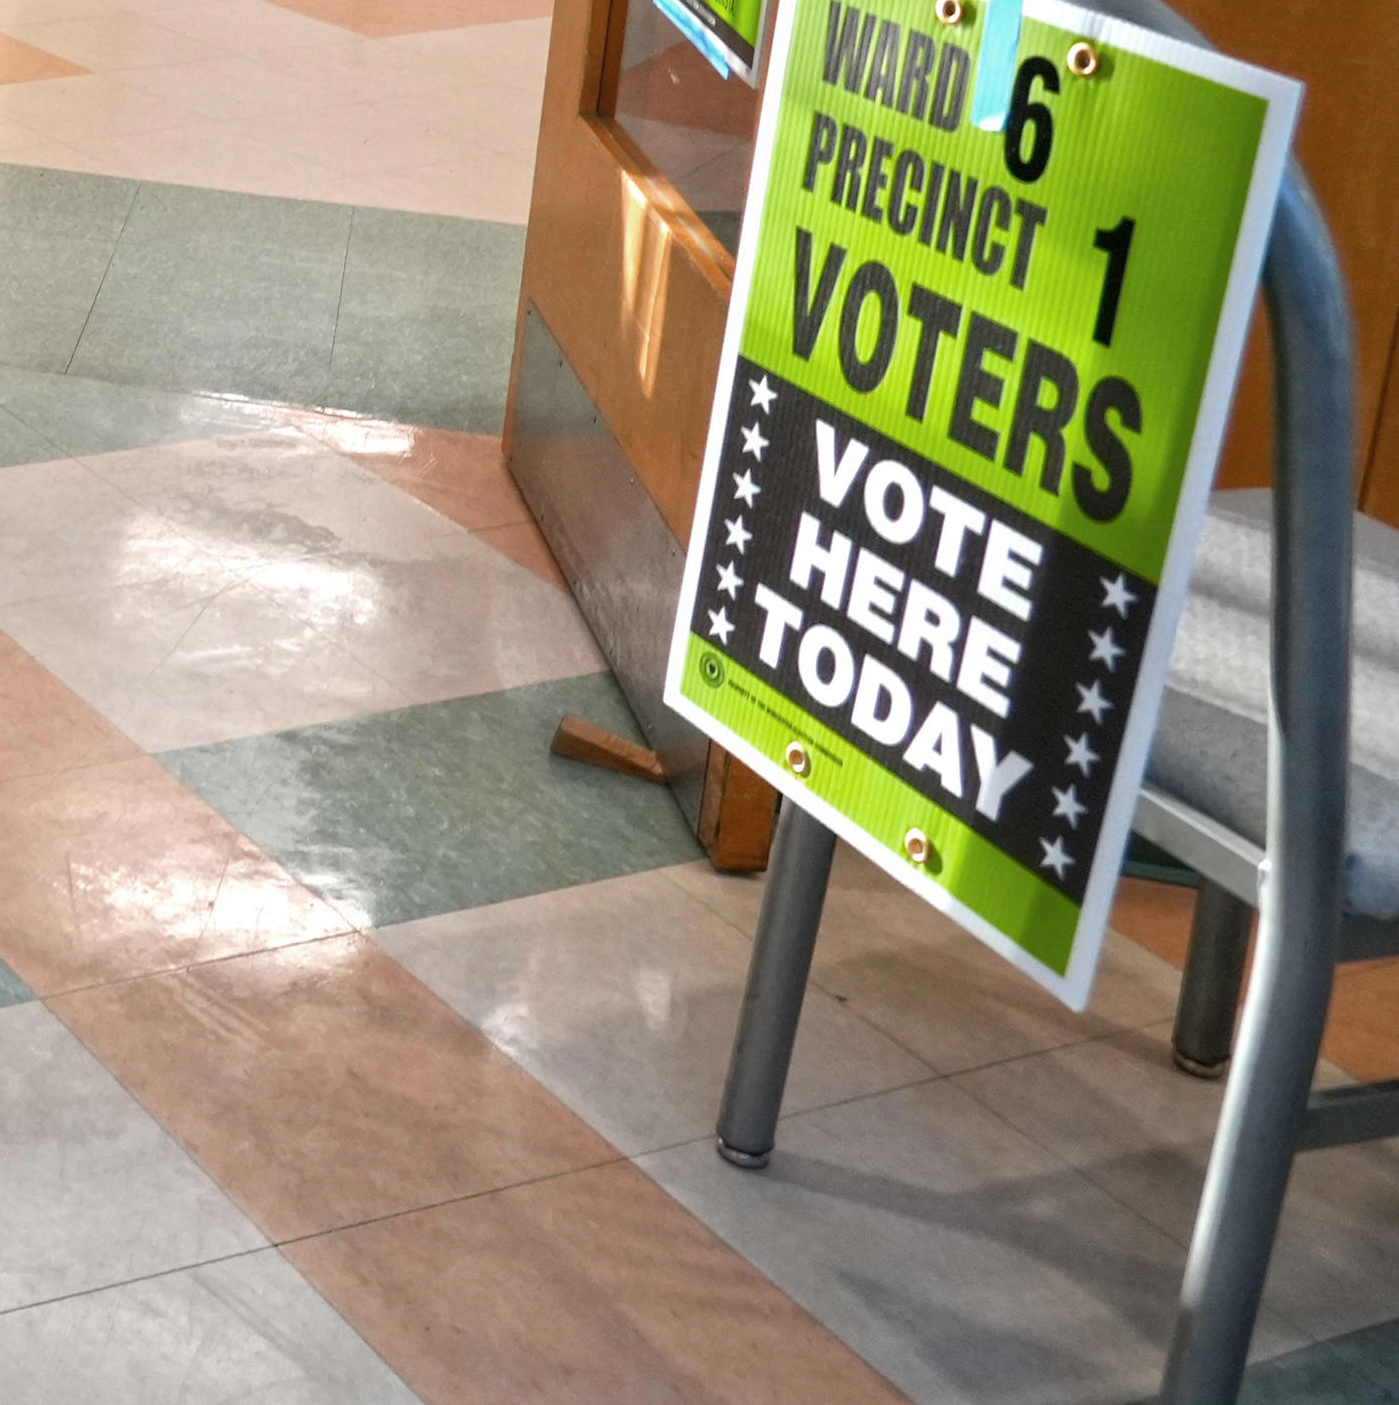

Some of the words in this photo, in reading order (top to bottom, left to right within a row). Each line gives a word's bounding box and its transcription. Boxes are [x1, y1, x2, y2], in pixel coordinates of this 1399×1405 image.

[820, 0, 970, 135] WARD
[1003, 56, 1062, 184] 6
[802, 111, 1048, 291] PRECINCT
[1091, 217, 1137, 348] 1
[790, 226, 1142, 525] VOTERS
[788, 512, 1024, 719] HERE
[813, 420, 1044, 624] VOTE
[753, 593, 1034, 824] TODAY
